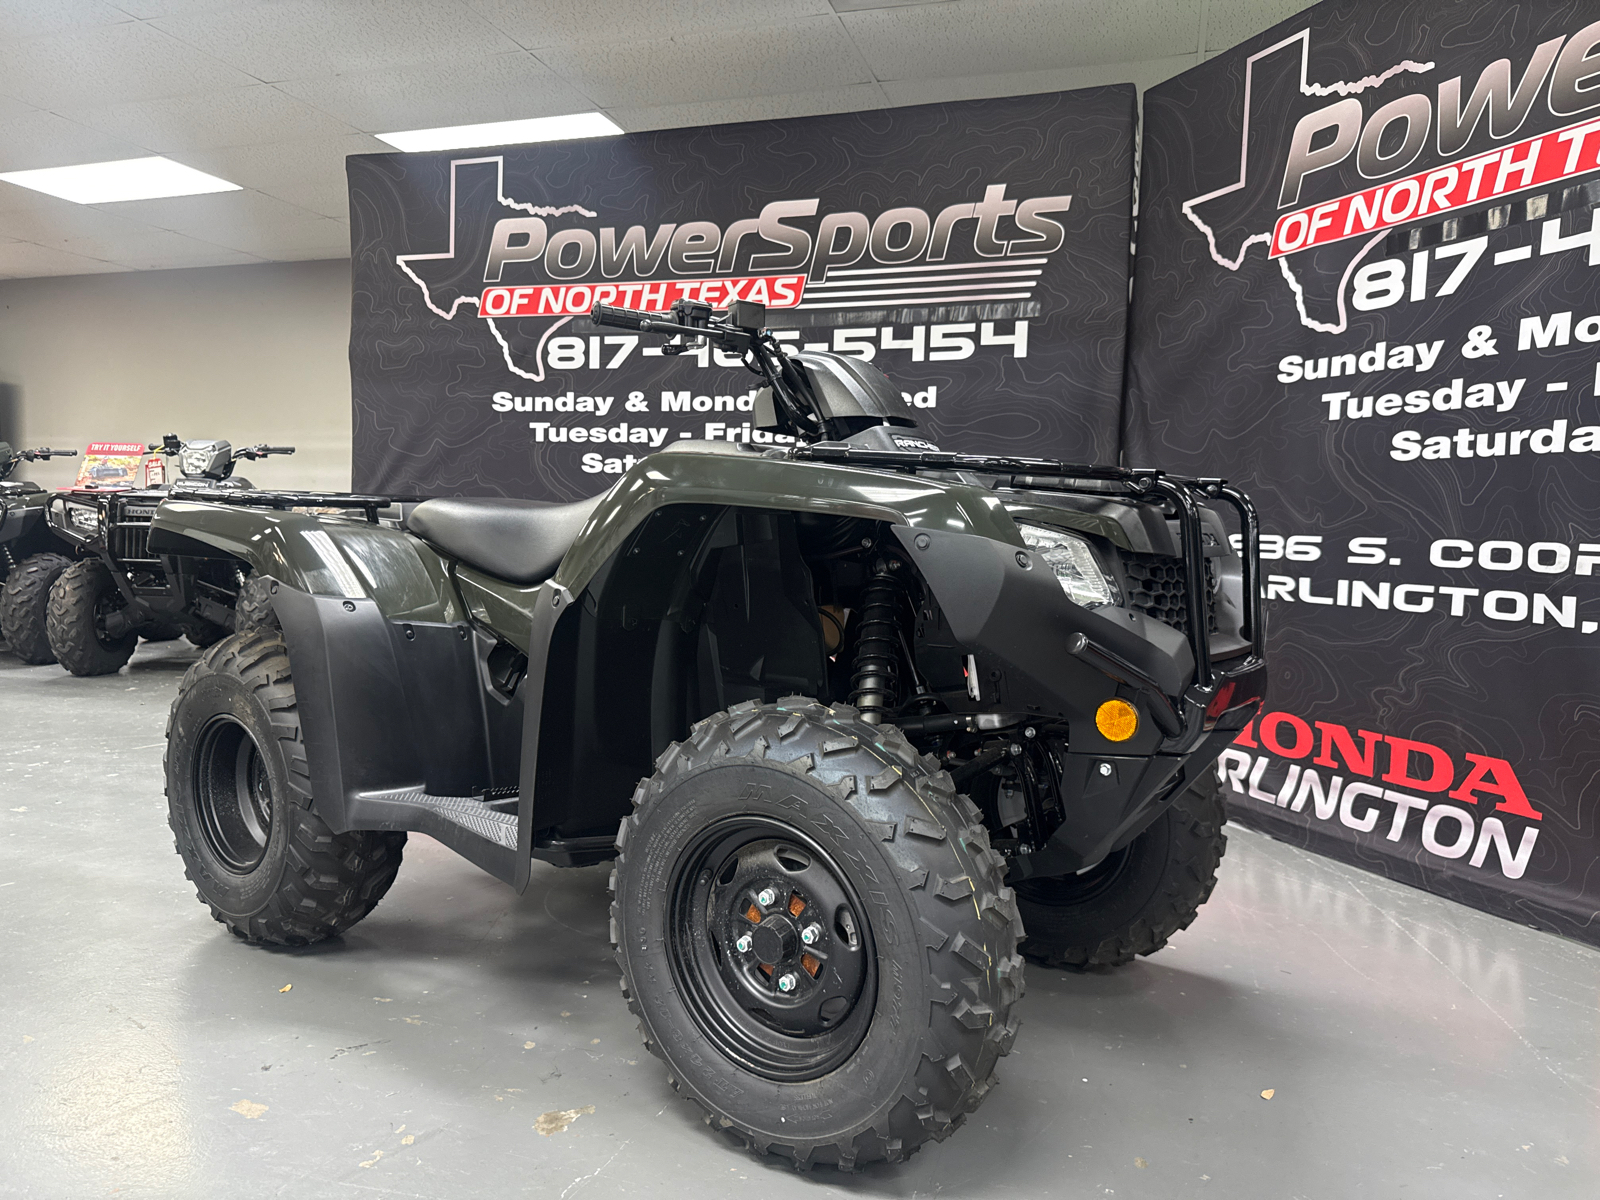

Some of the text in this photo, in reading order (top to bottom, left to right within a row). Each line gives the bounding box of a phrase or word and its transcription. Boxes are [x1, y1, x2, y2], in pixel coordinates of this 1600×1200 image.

[1277, 120, 1600, 252] OF NORTH T
[483, 184, 1073, 284] PowerSports
[485, 276, 797, 314] OF NORTH TEXAS
[1277, 310, 1600, 384] Sunday & Mo
[491, 389, 757, 416] Sunday & Mond
[1321, 378, 1526, 421] Tuesday
[529, 421, 669, 447] Tuesday
[1389, 417, 1600, 462] Saturda
[148, 460, 162, 468] SALE
[1347, 537, 1401, 566] S.
[1261, 574, 1599, 634] RLINGTON,
[1217, 747, 1540, 880] RLINGTON
[737, 782, 899, 946] MAXXIS
